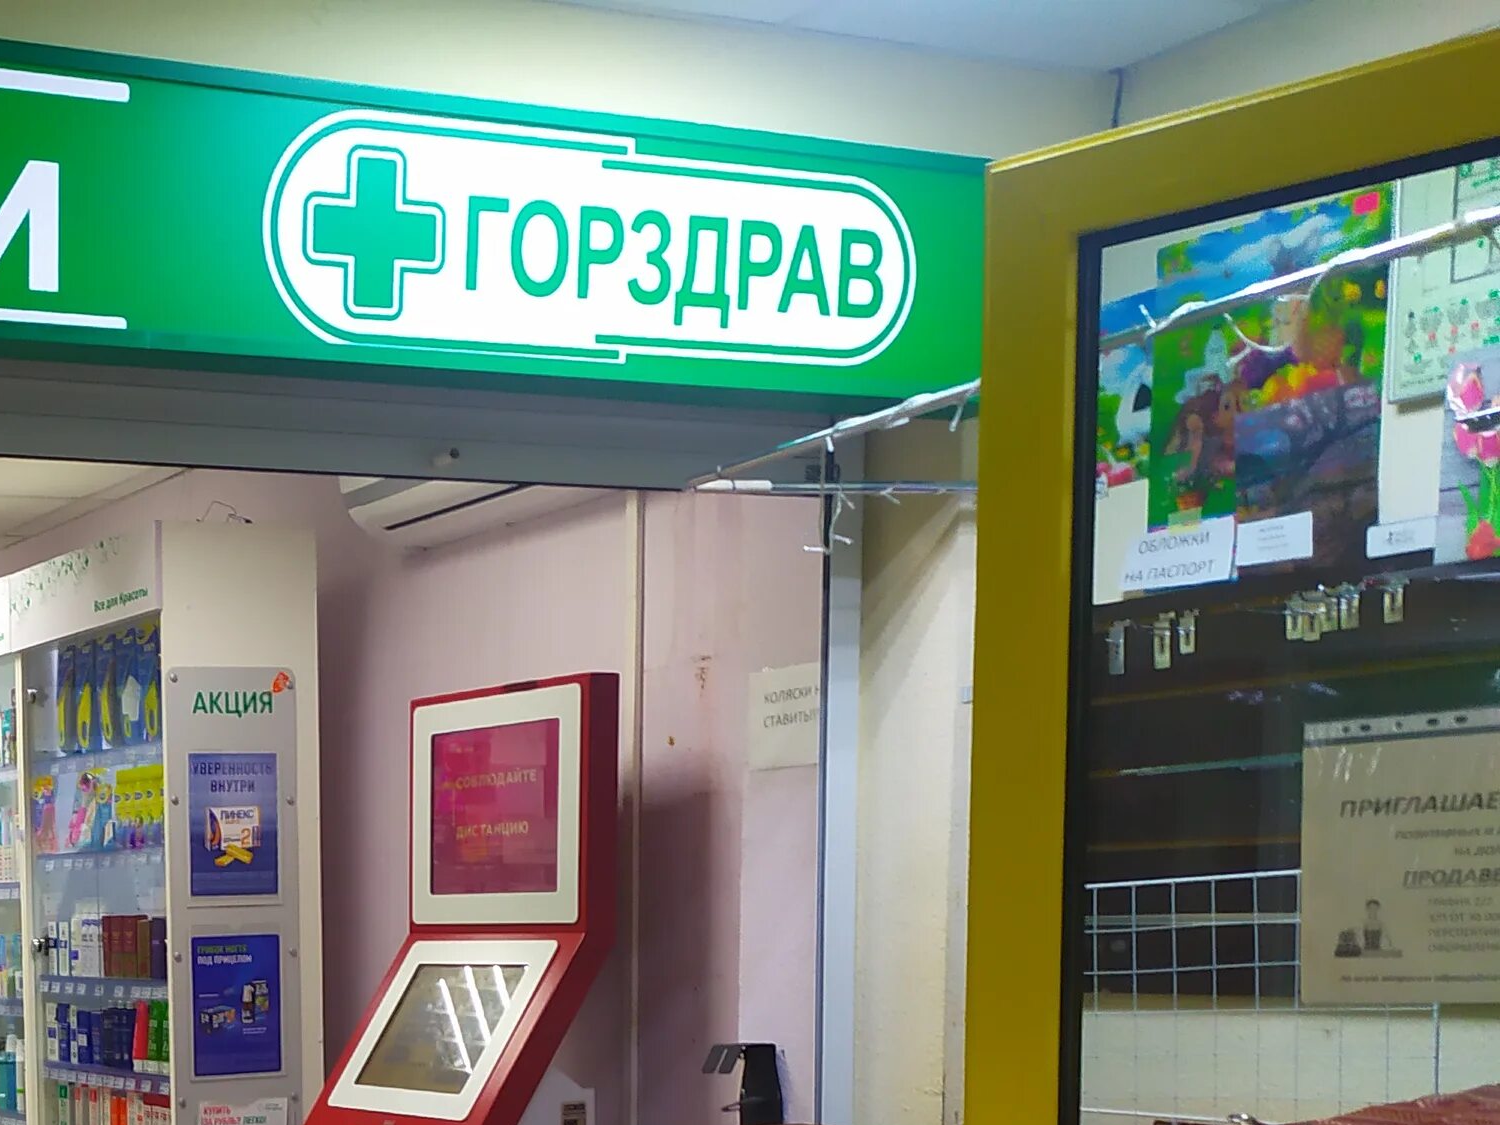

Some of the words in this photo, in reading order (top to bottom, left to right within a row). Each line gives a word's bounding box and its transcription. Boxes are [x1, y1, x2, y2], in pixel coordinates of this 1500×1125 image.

[466, 196, 884, 329] ГОРЗДРАВ
[192, 691, 273, 718] АКЦИЯ
[210, 779, 255, 793] ВНУТРИ
